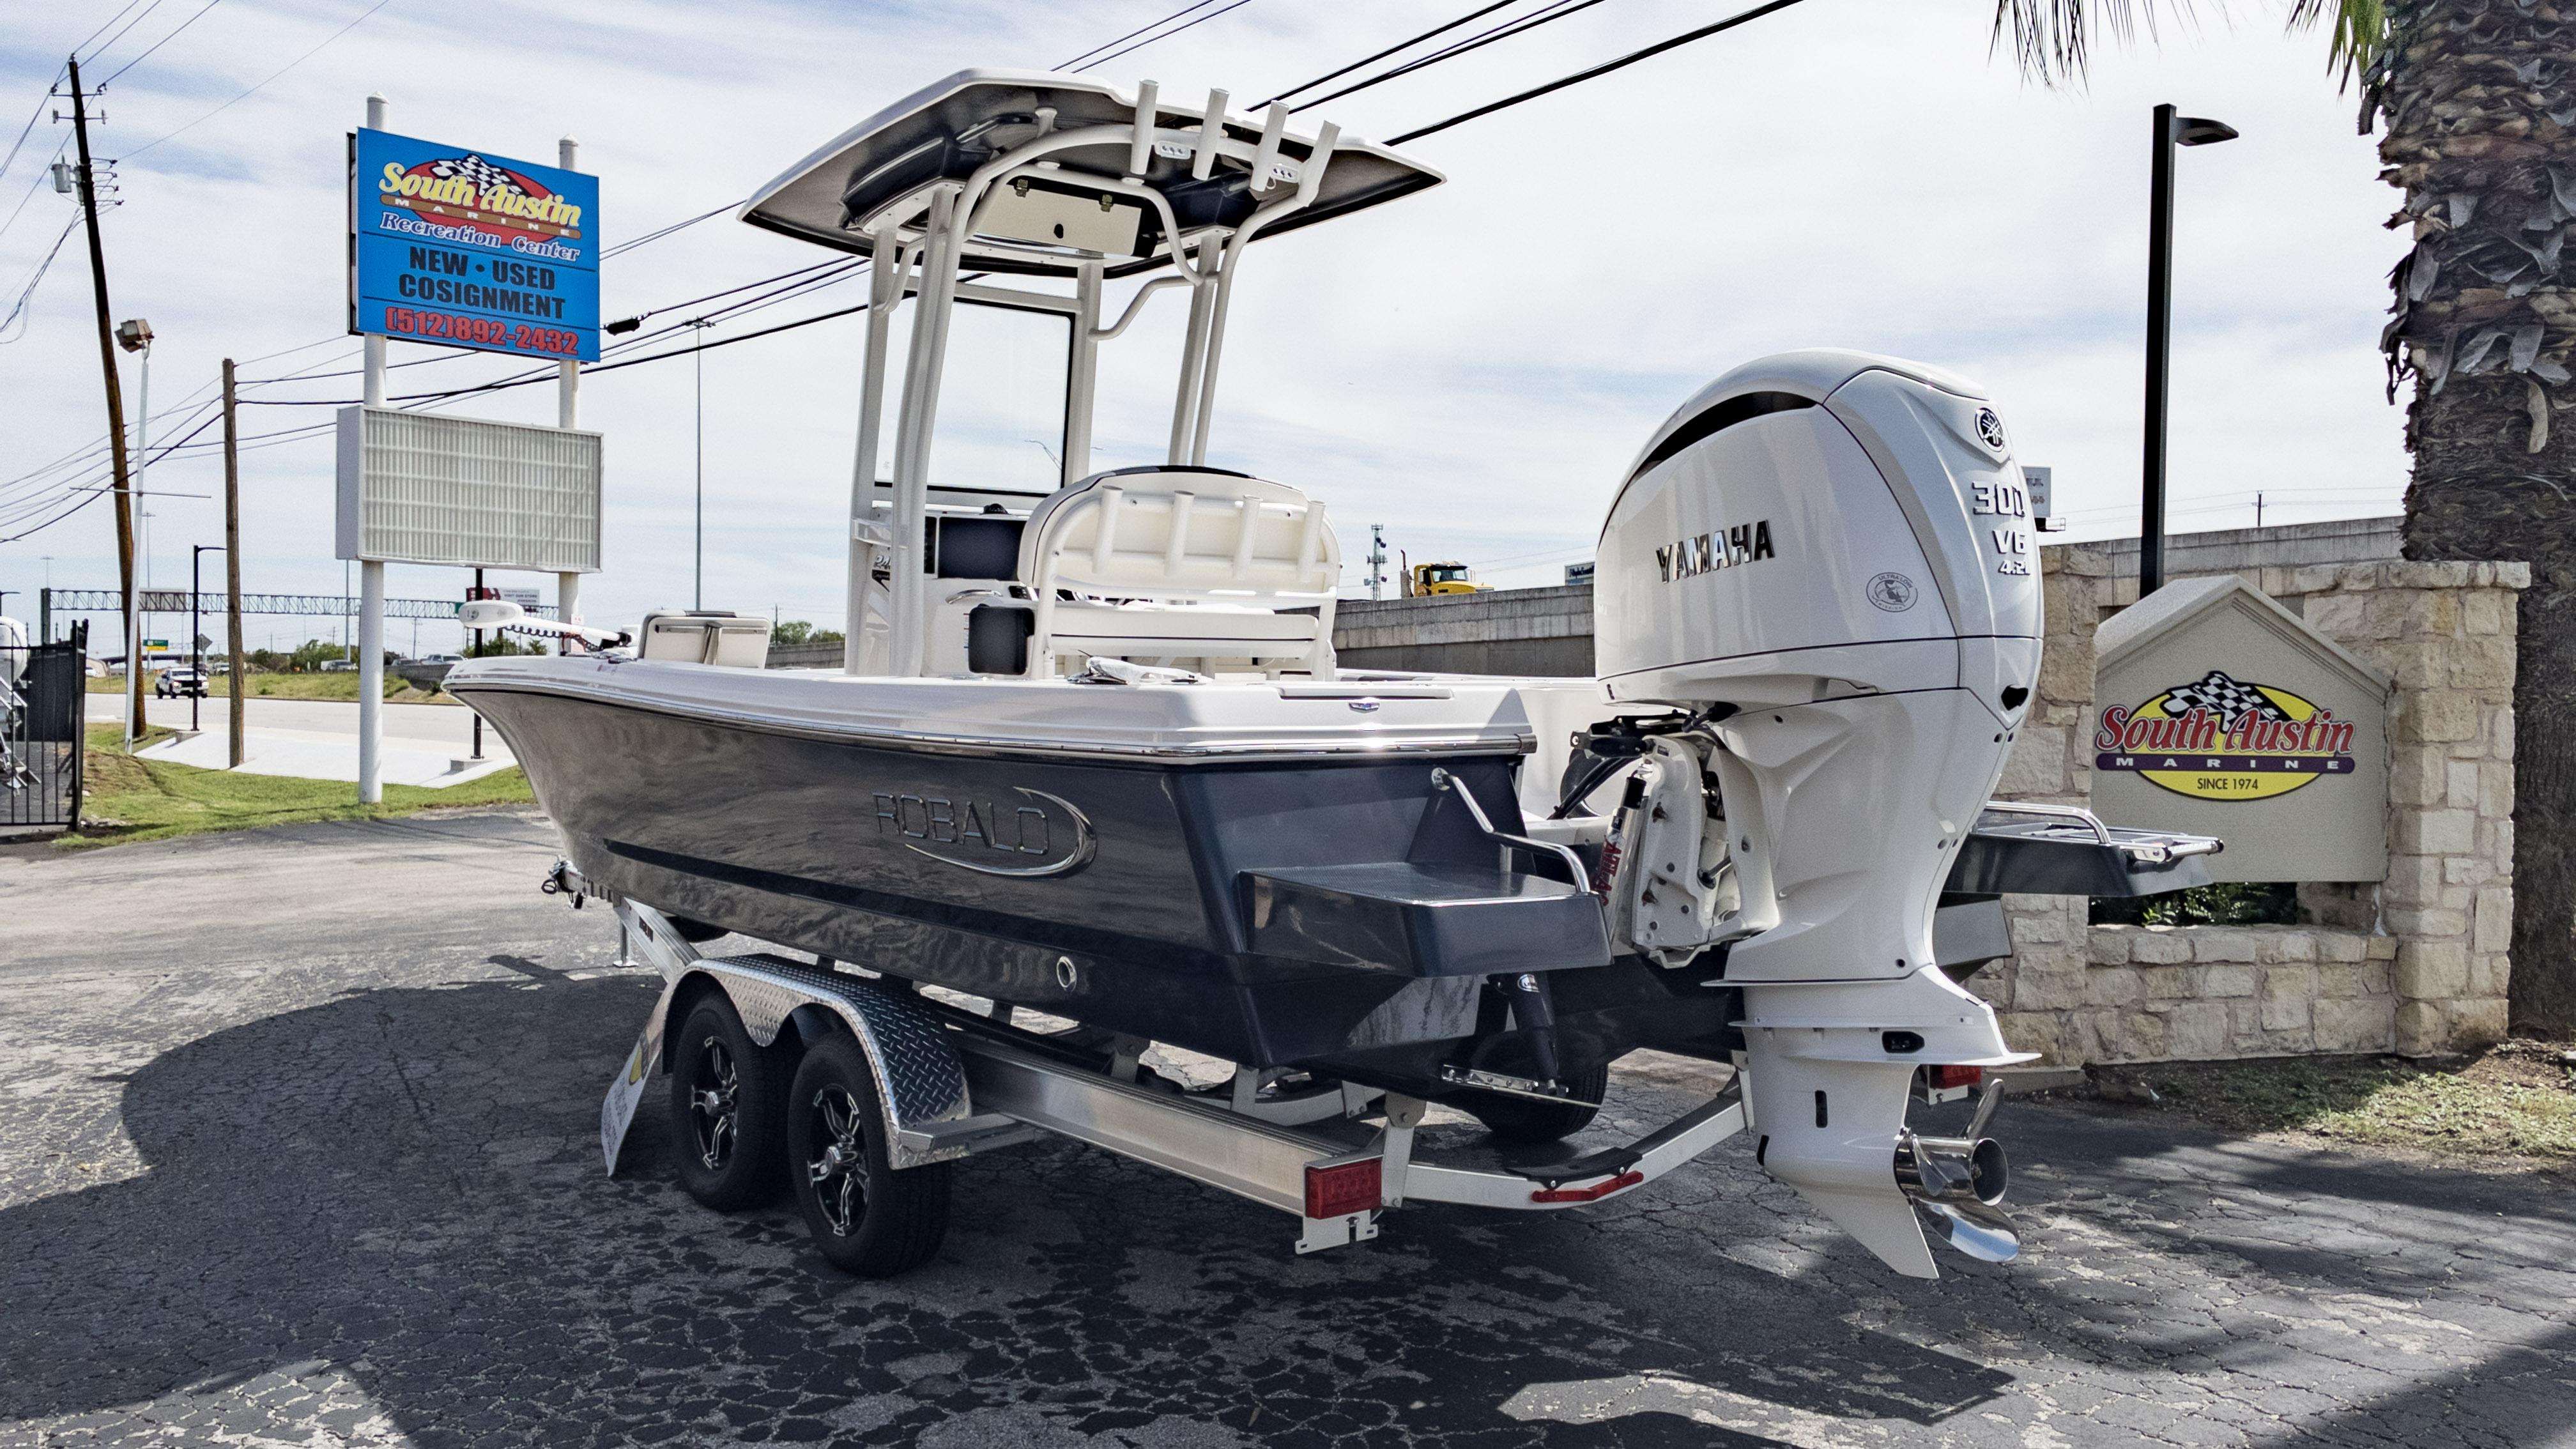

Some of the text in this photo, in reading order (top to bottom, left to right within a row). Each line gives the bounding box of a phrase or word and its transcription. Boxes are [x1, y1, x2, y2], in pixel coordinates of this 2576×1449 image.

[379, 162, 581, 227] South Austin
[394, 198, 571, 236] MARINE
[379, 211, 581, 262] Recreation Center
[410, 246, 555, 291] NEW USED
[399, 273, 565, 319] COSIGNMENT
[385, 306, 578, 355] (512)892-2432
[1972, 480, 2025, 518] 300
[1656, 519, 1775, 584] YAMAHA
[1991, 530, 2027, 555] V6
[2096, 705, 2356, 755] South Austin
[2115, 757, 2339, 770] MARINE
[2197, 778, 2258, 790] SINCE 1974
[873, 792, 1050, 855] ROBALO
